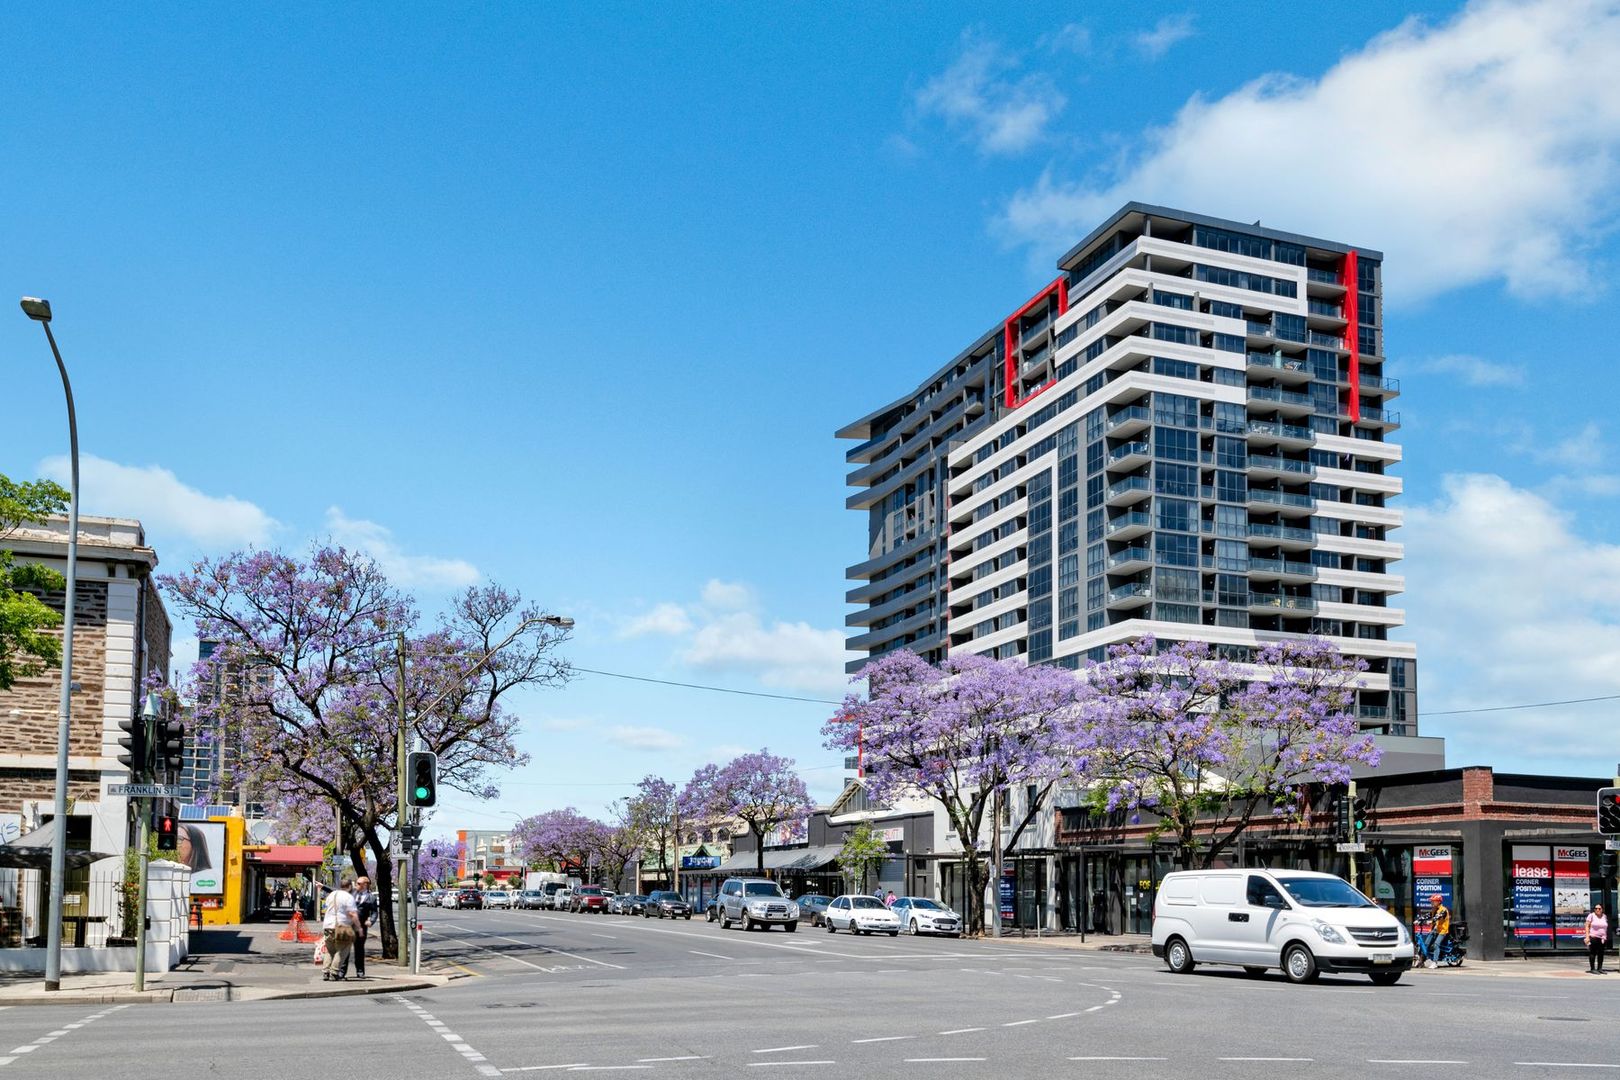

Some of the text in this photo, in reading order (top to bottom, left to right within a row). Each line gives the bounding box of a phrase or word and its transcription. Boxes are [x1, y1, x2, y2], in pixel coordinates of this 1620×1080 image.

[118, 785, 175, 795] FRANKLIN ST
[1557, 849, 1587, 858] McGEES
